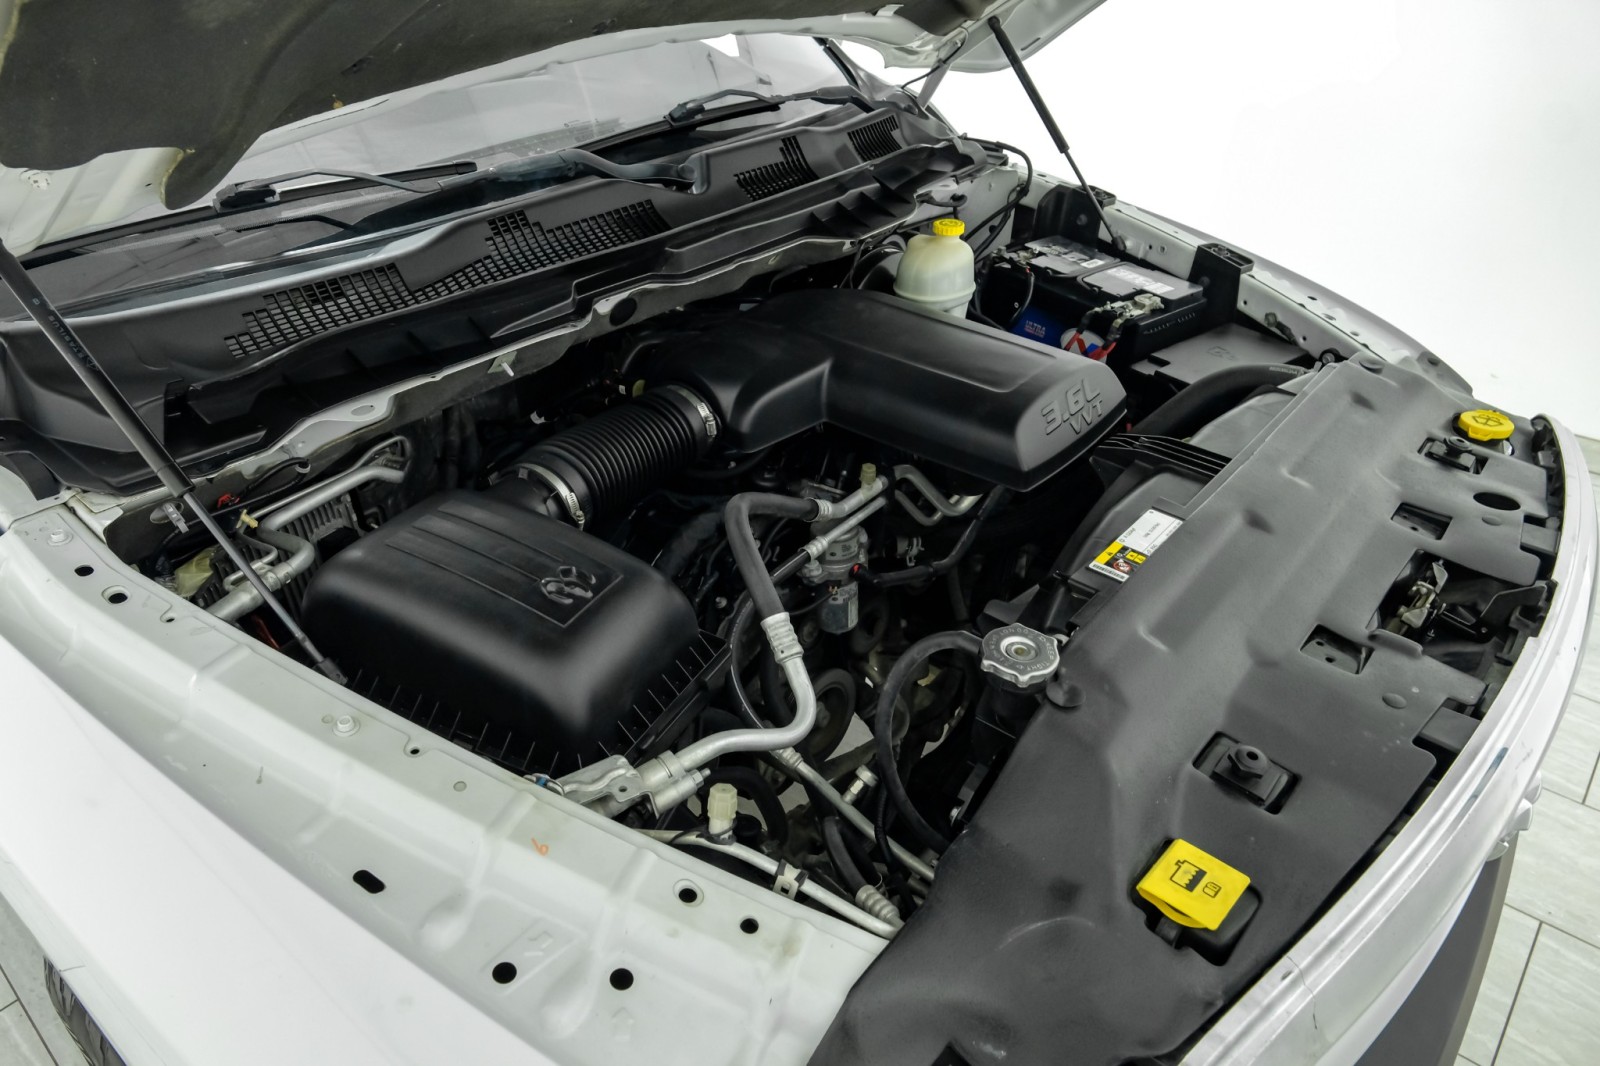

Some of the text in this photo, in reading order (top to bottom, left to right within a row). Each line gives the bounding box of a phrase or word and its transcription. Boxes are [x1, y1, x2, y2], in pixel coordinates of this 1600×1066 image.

[1041, 379, 1101, 436] 3.6L
[1069, 400, 1103, 435] VVT
[1026, 661, 1050, 671] TIGHT
